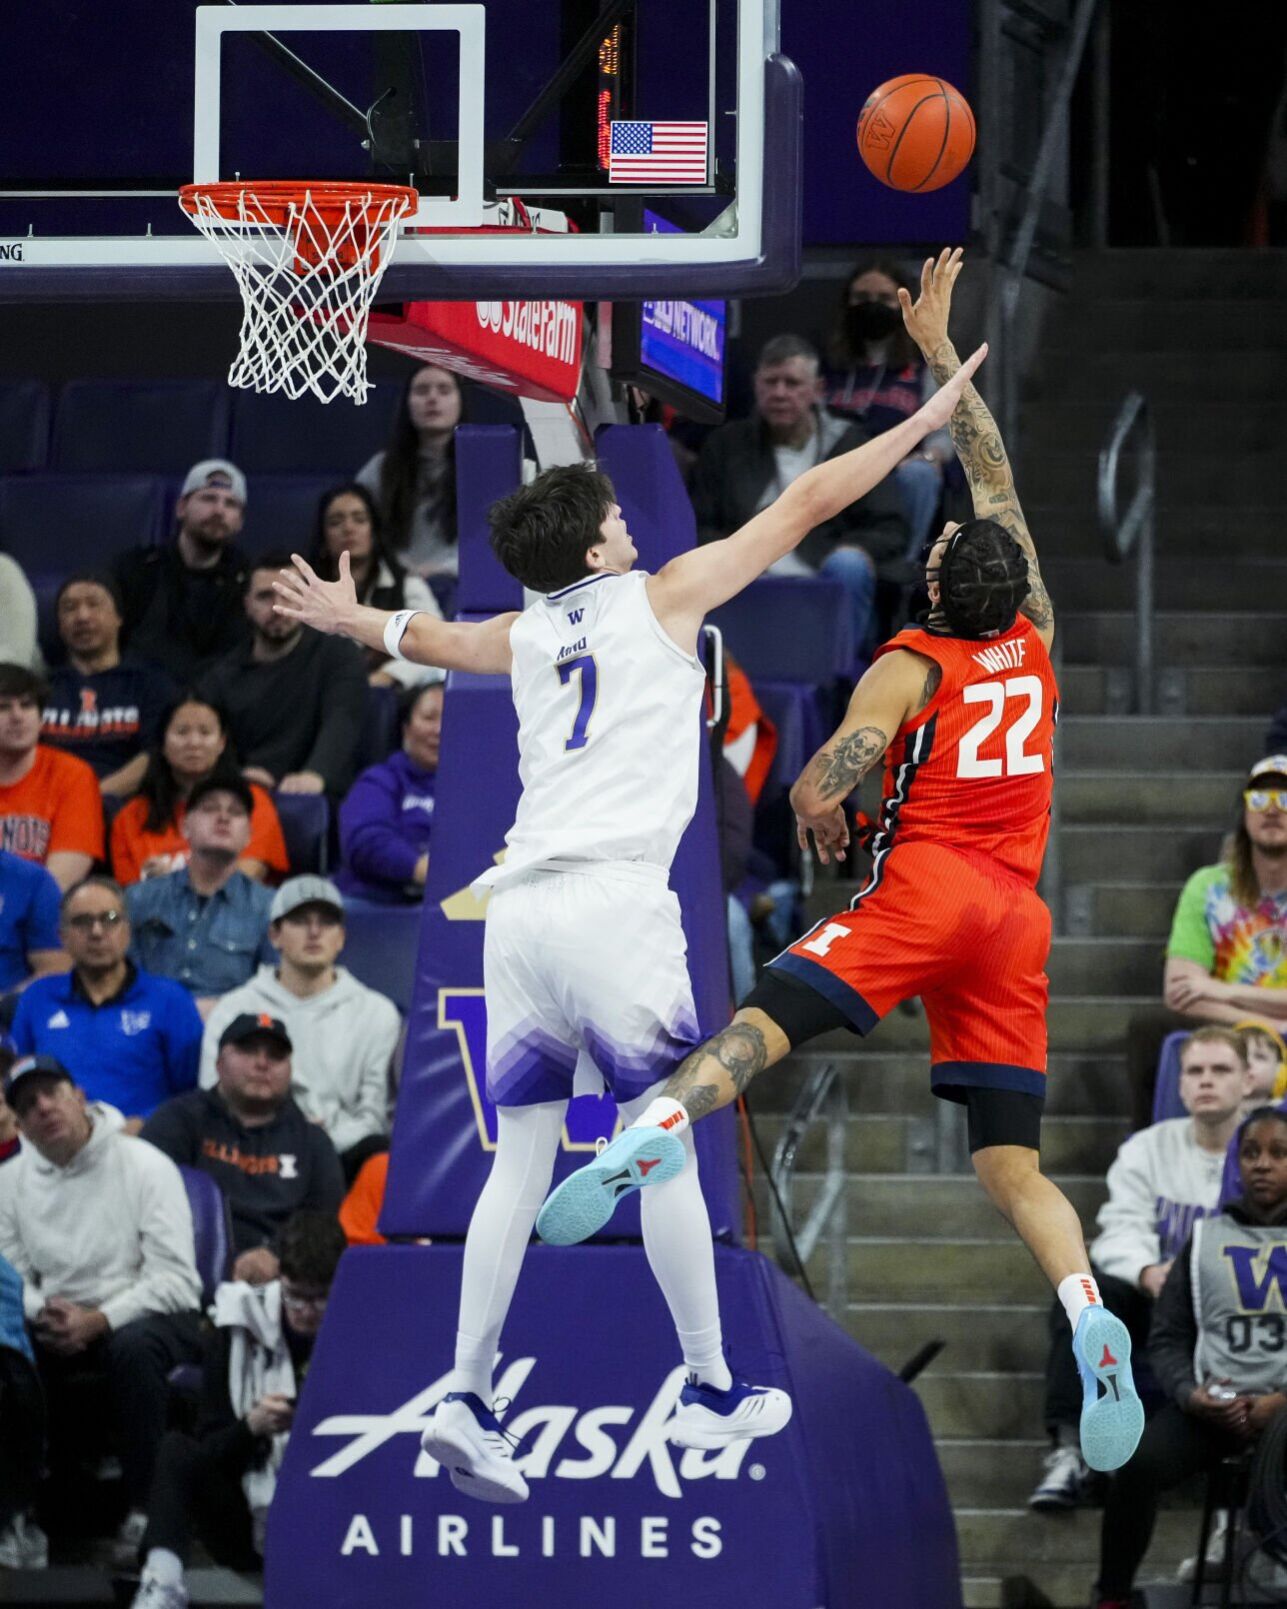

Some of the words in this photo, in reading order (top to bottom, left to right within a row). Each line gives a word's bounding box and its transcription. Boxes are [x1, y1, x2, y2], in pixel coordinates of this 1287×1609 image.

[568, 608, 585, 626] W
[971, 638, 1026, 674] WHITE
[554, 651, 599, 752] 7
[956, 675, 1045, 778] 22
[340, 1515, 724, 1559] AIRLINES
